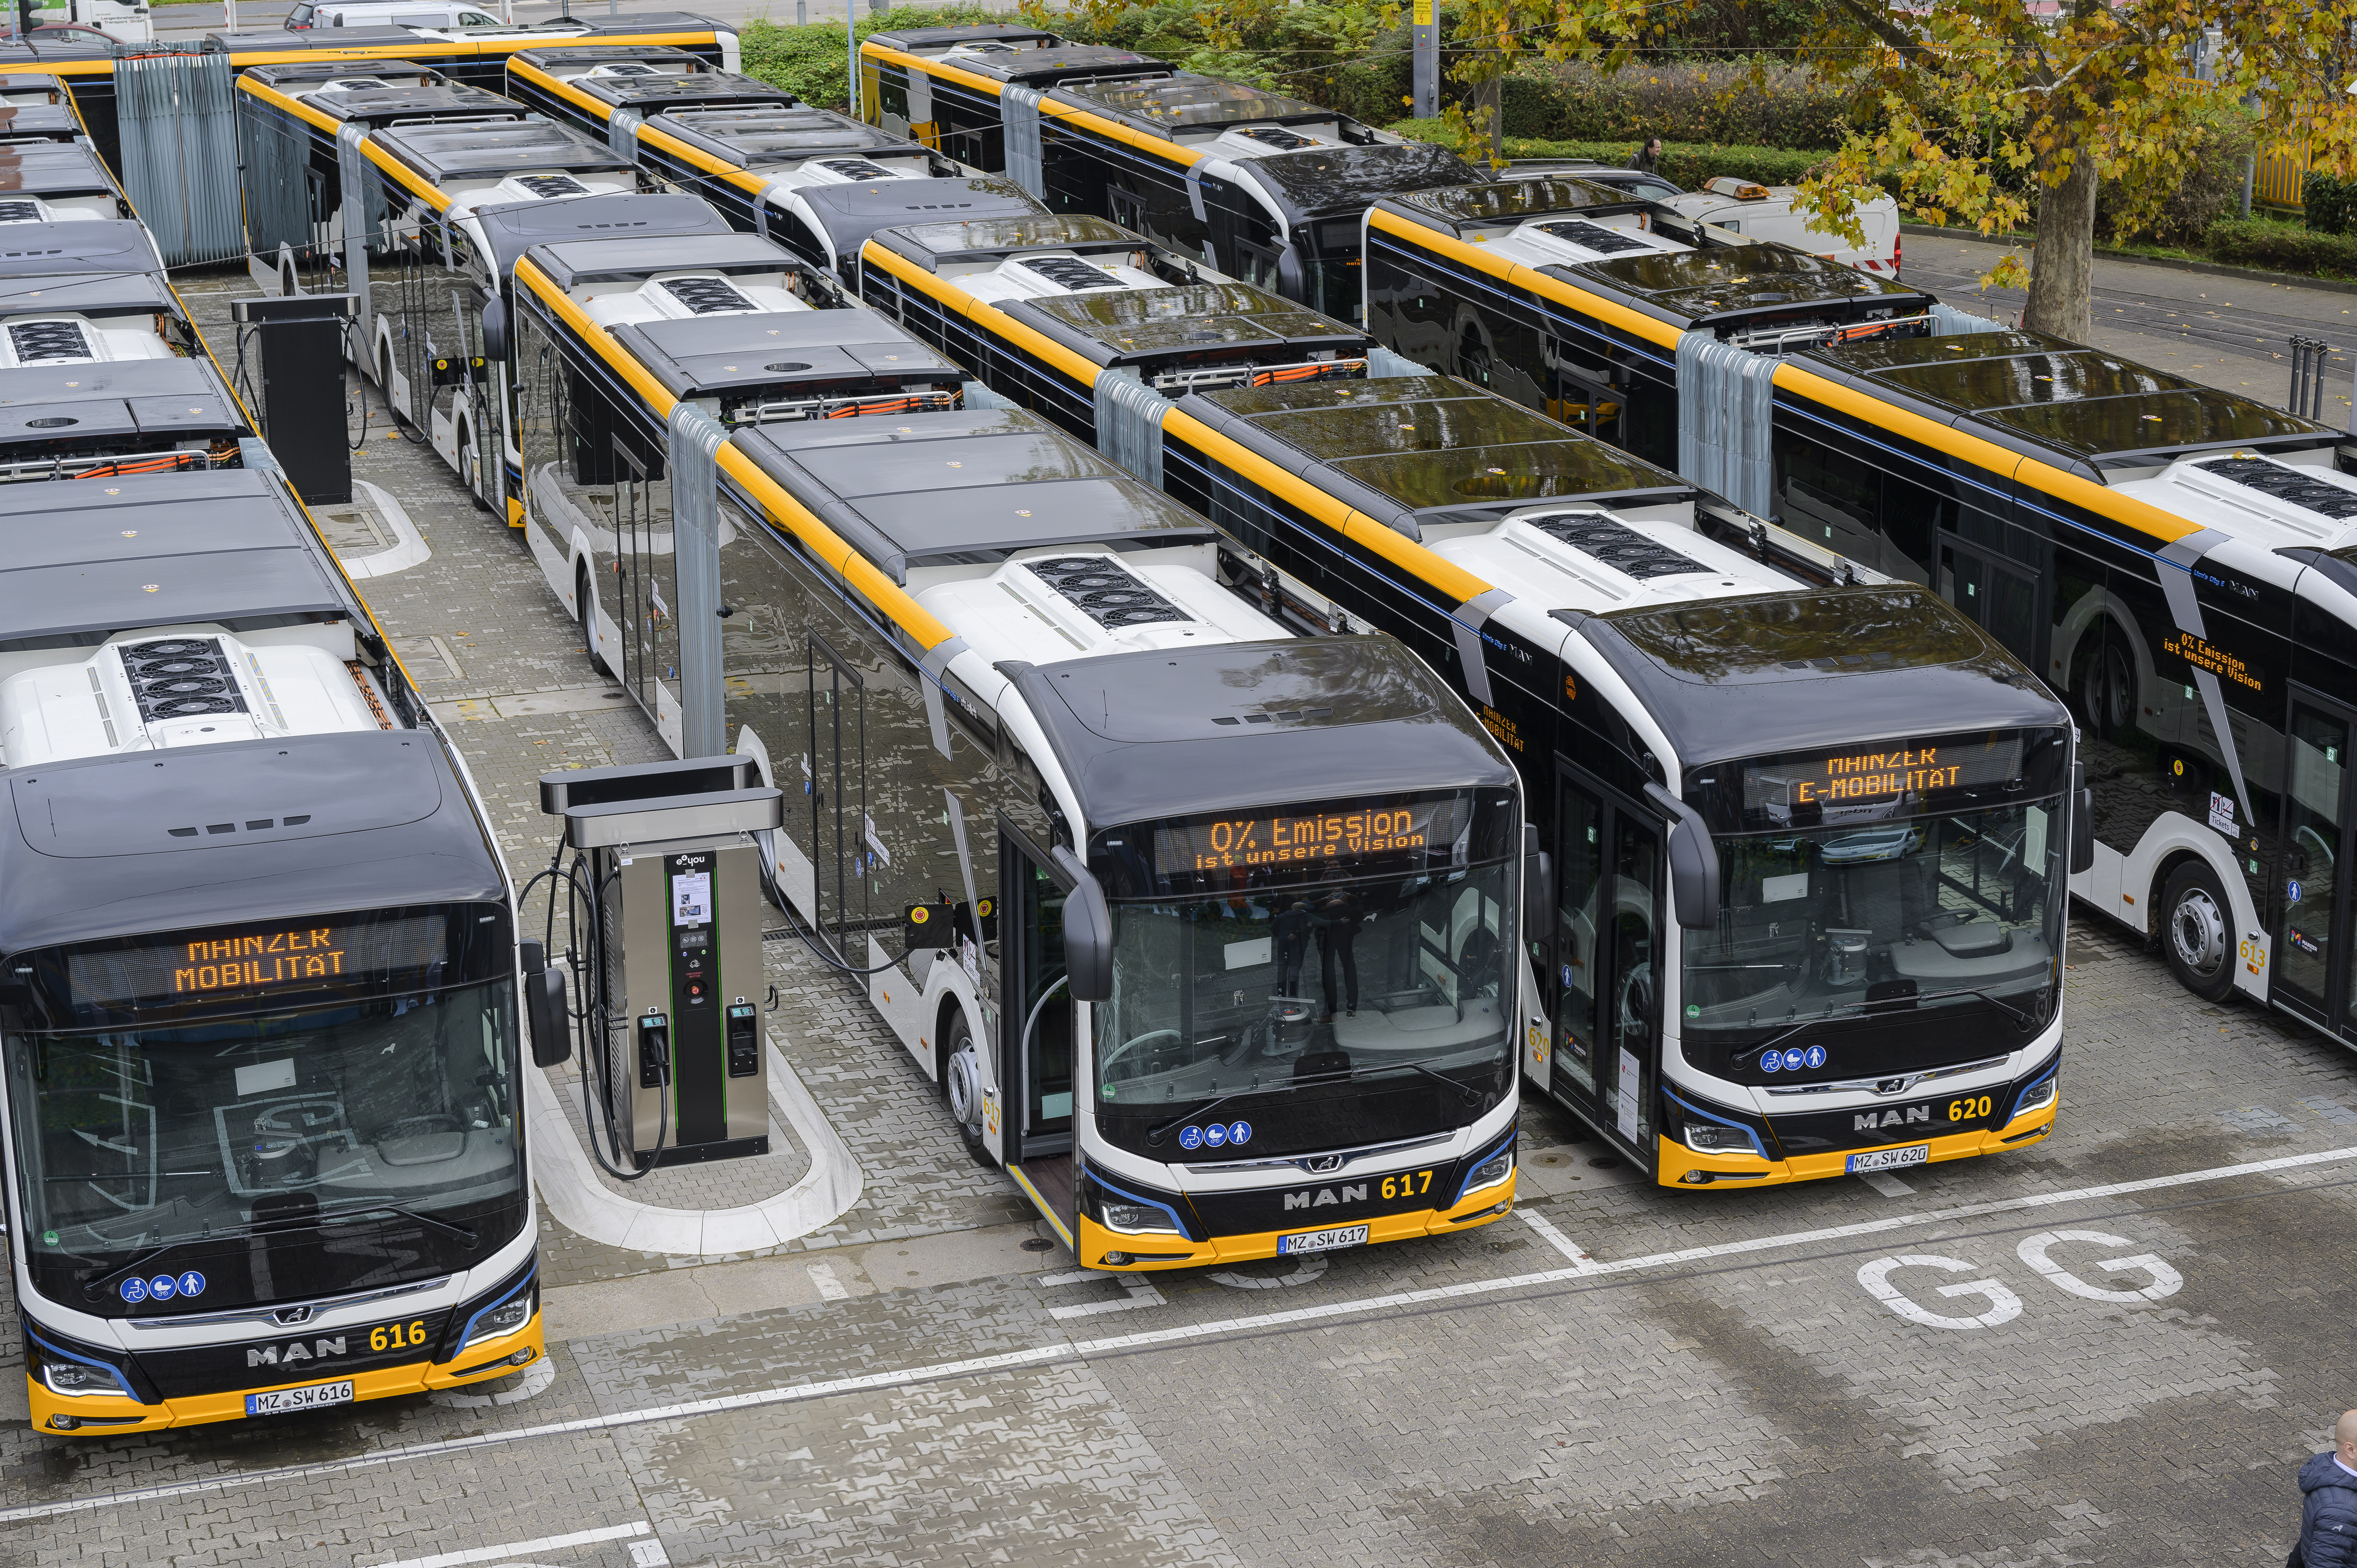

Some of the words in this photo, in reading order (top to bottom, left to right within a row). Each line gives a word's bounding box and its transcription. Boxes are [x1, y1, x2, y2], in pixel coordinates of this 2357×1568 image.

[2230, 580, 2259, 601] MAN
[1509, 644, 1532, 666] MAN
[2164, 638, 2180, 654] ist
[2184, 650, 2223, 673] unsere
[2228, 666, 2261, 690] Vision
[2181, 633, 2194, 649] 0%
[2198, 640, 2245, 671] Emission
[961, 696, 978, 719] MAN
[1483, 705, 1516, 733] MAINZER
[1828, 748, 1936, 774] MAINZER
[1799, 766, 1960, 802] E-MOBILITÄT
[1211, 821, 1256, 852] 0%
[1274, 809, 1412, 847] Emission
[2212, 815, 2229, 830] Tickets
[876, 841, 885, 857] Tickets
[1197, 852, 1234, 869] ist
[1247, 844, 1336, 864] unsere
[1348, 835, 1423, 851] Vision
[189, 928, 330, 961] MAINZER
[2240, 940, 2265, 967] 613
[2302, 939, 2317, 952] MAINZER
[176, 951, 344, 991] MOBILITÄT
[964, 959, 975, 977] Tickets
[1529, 1027, 1549, 1056] 620
[1574, 1043, 1586, 1056] MAINZER
[984, 1097, 1000, 1126] 617
[1854, 1105, 1929, 1130] MAN
[1949, 1096, 1991, 1121] 620
[1855, 1155, 1872, 1169] MZ
[1881, 1151, 1899, 1165] SW
[1901, 1148, 1926, 1162] 620
[1284, 1184, 1367, 1210] MAN
[1382, 1171, 1432, 1199] 617
[1288, 1236, 1306, 1250] MZ
[1317, 1232, 1336, 1246] SW
[1339, 1228, 1366, 1242] 617
[370, 1321, 426, 1351] 616
[247, 1336, 346, 1367] MAN
[258, 1394, 281, 1410] MZ
[293, 1389, 313, 1404] SW
[319, 1384, 350, 1401] 616
